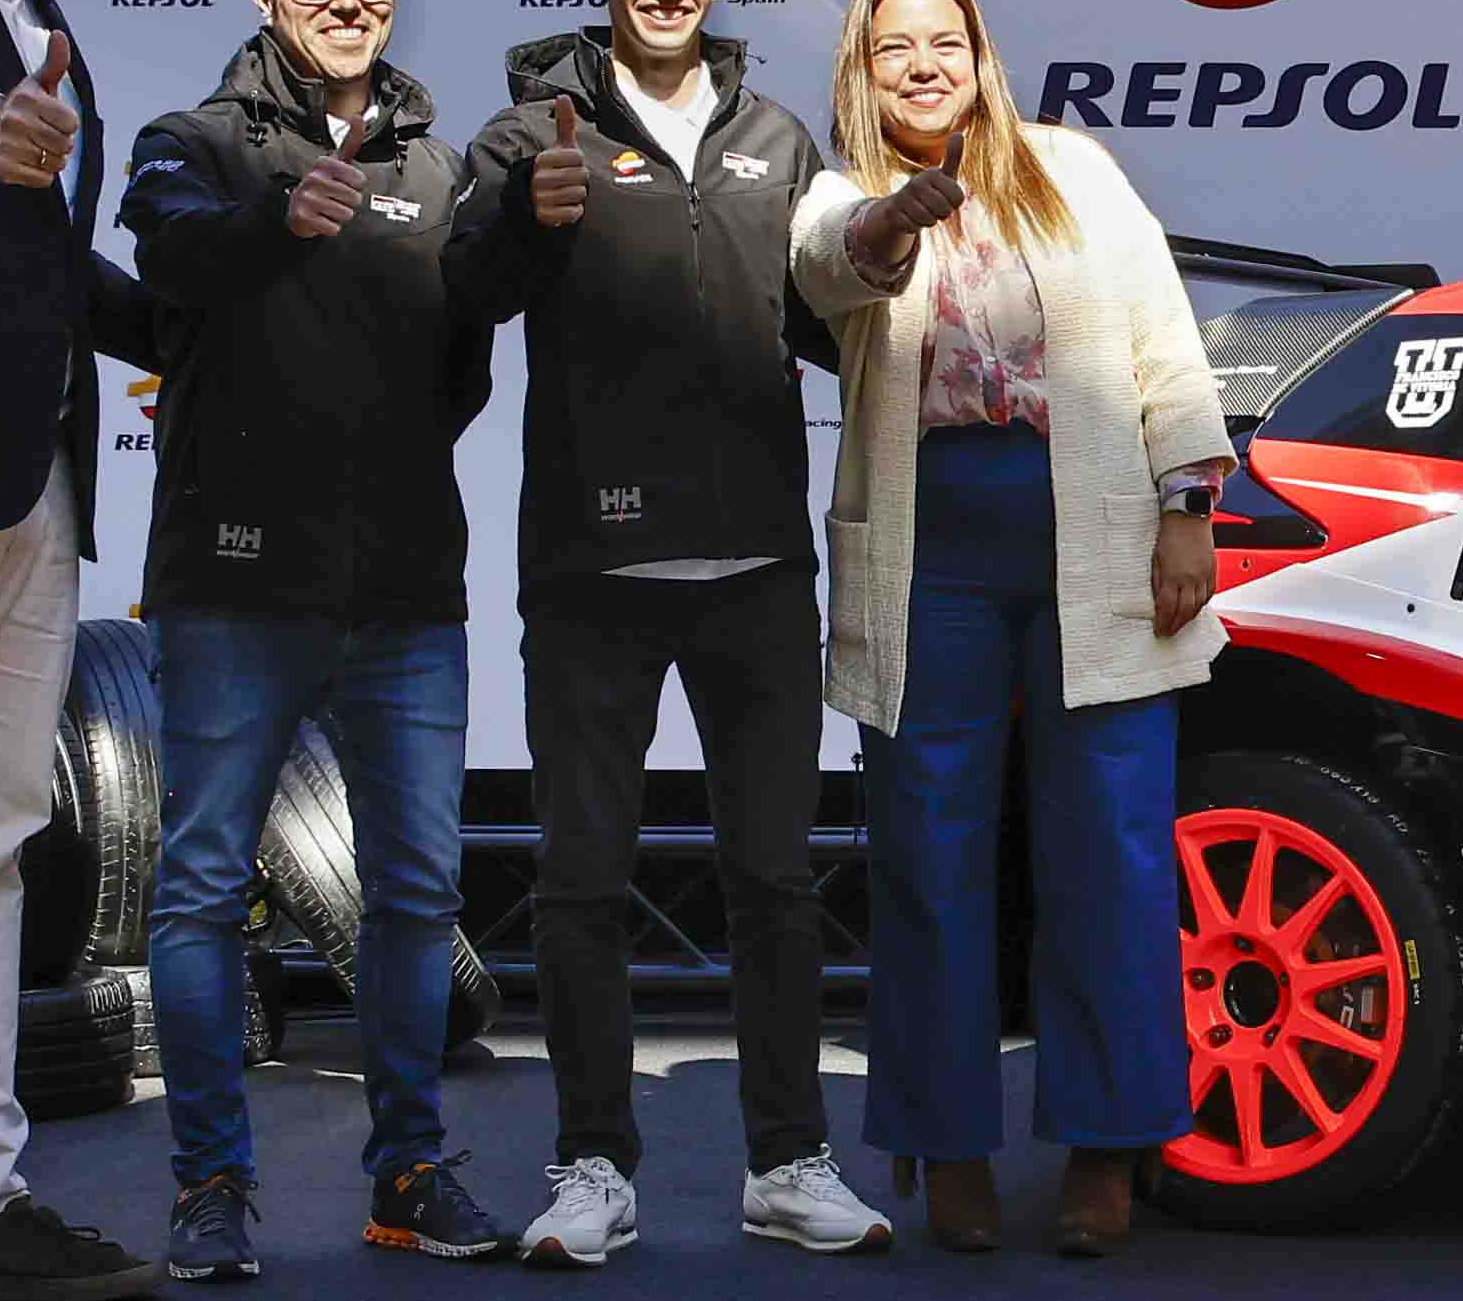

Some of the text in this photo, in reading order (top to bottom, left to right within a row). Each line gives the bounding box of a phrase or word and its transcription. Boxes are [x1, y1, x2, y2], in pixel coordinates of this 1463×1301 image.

[1039, 59, 1460, 131] REPSOL
[805, 416, 841, 430] acing
[600, 487, 641, 510] HH
[218, 524, 262, 549] HH
